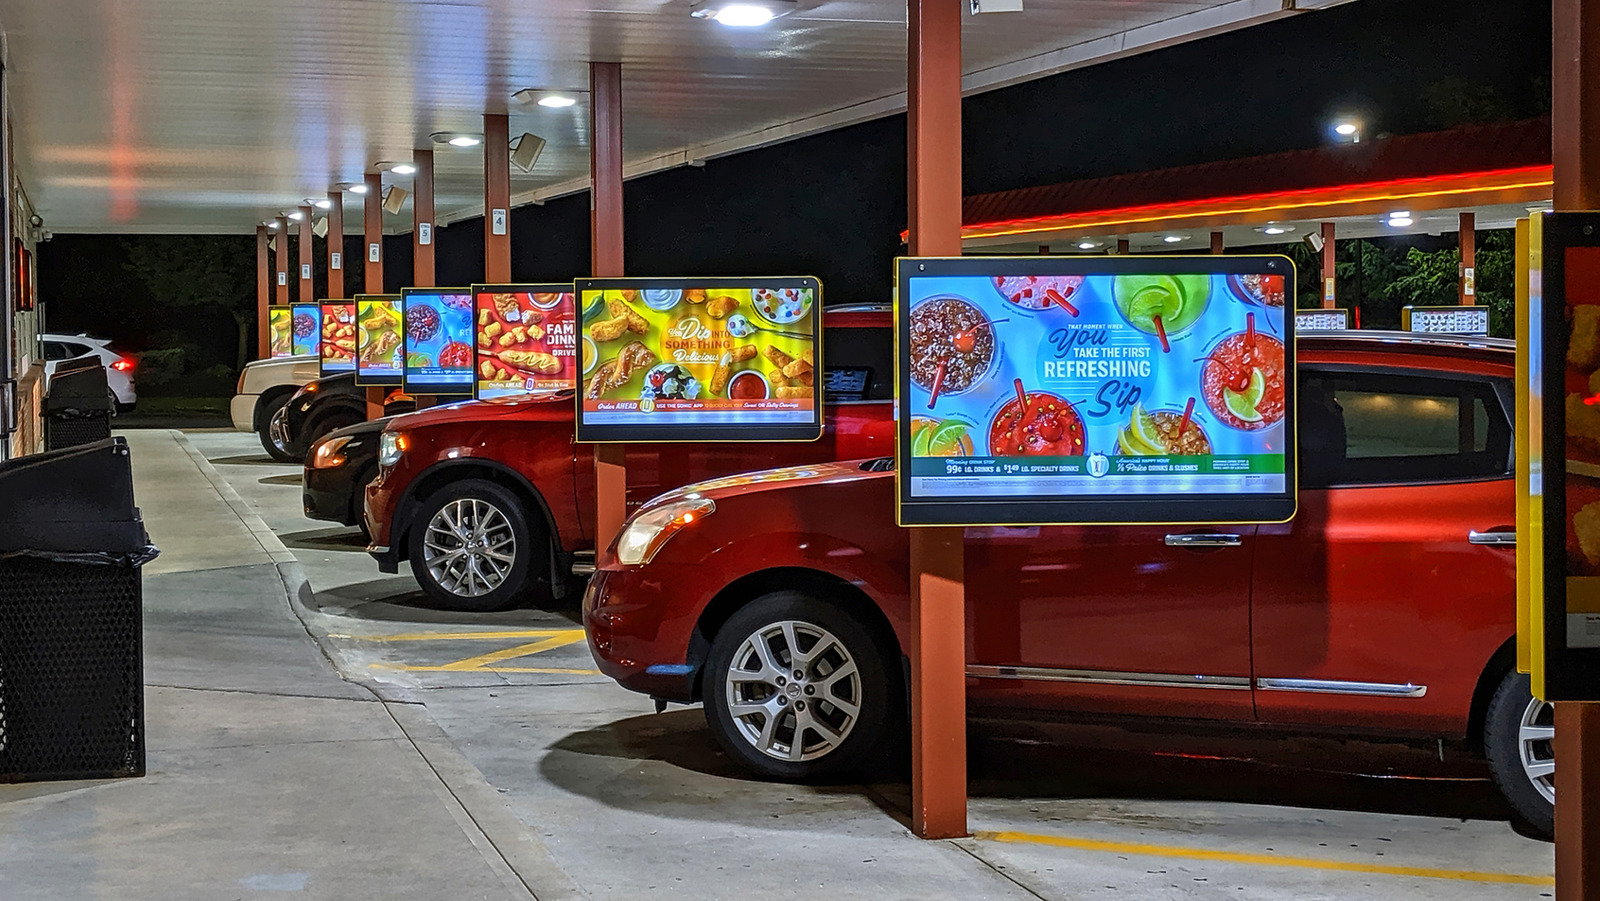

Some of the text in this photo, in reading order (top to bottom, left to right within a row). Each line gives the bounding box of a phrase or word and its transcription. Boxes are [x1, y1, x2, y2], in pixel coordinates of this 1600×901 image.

[496, 216, 503, 226] 4
[422, 229, 428, 237] 5
[678, 317, 711, 341] Dip
[711, 330, 730, 339] INTO
[665, 340, 731, 350] SOMETHING
[1048, 328, 1108, 359] You
[672, 349, 720, 361] Delicious
[1073, 347, 1151, 358] TAKE THE FIRST
[1044, 360, 1151, 378] REFRESHING
[1087, 379, 1142, 418] Sip
[597, 402, 615, 410] Order
[615, 402, 638, 410] AHEAD
[1030, 465, 1059, 473] SPECIALTY
[1059, 465, 1080, 473] DRINKS
[1125, 463, 1147, 472] Price
